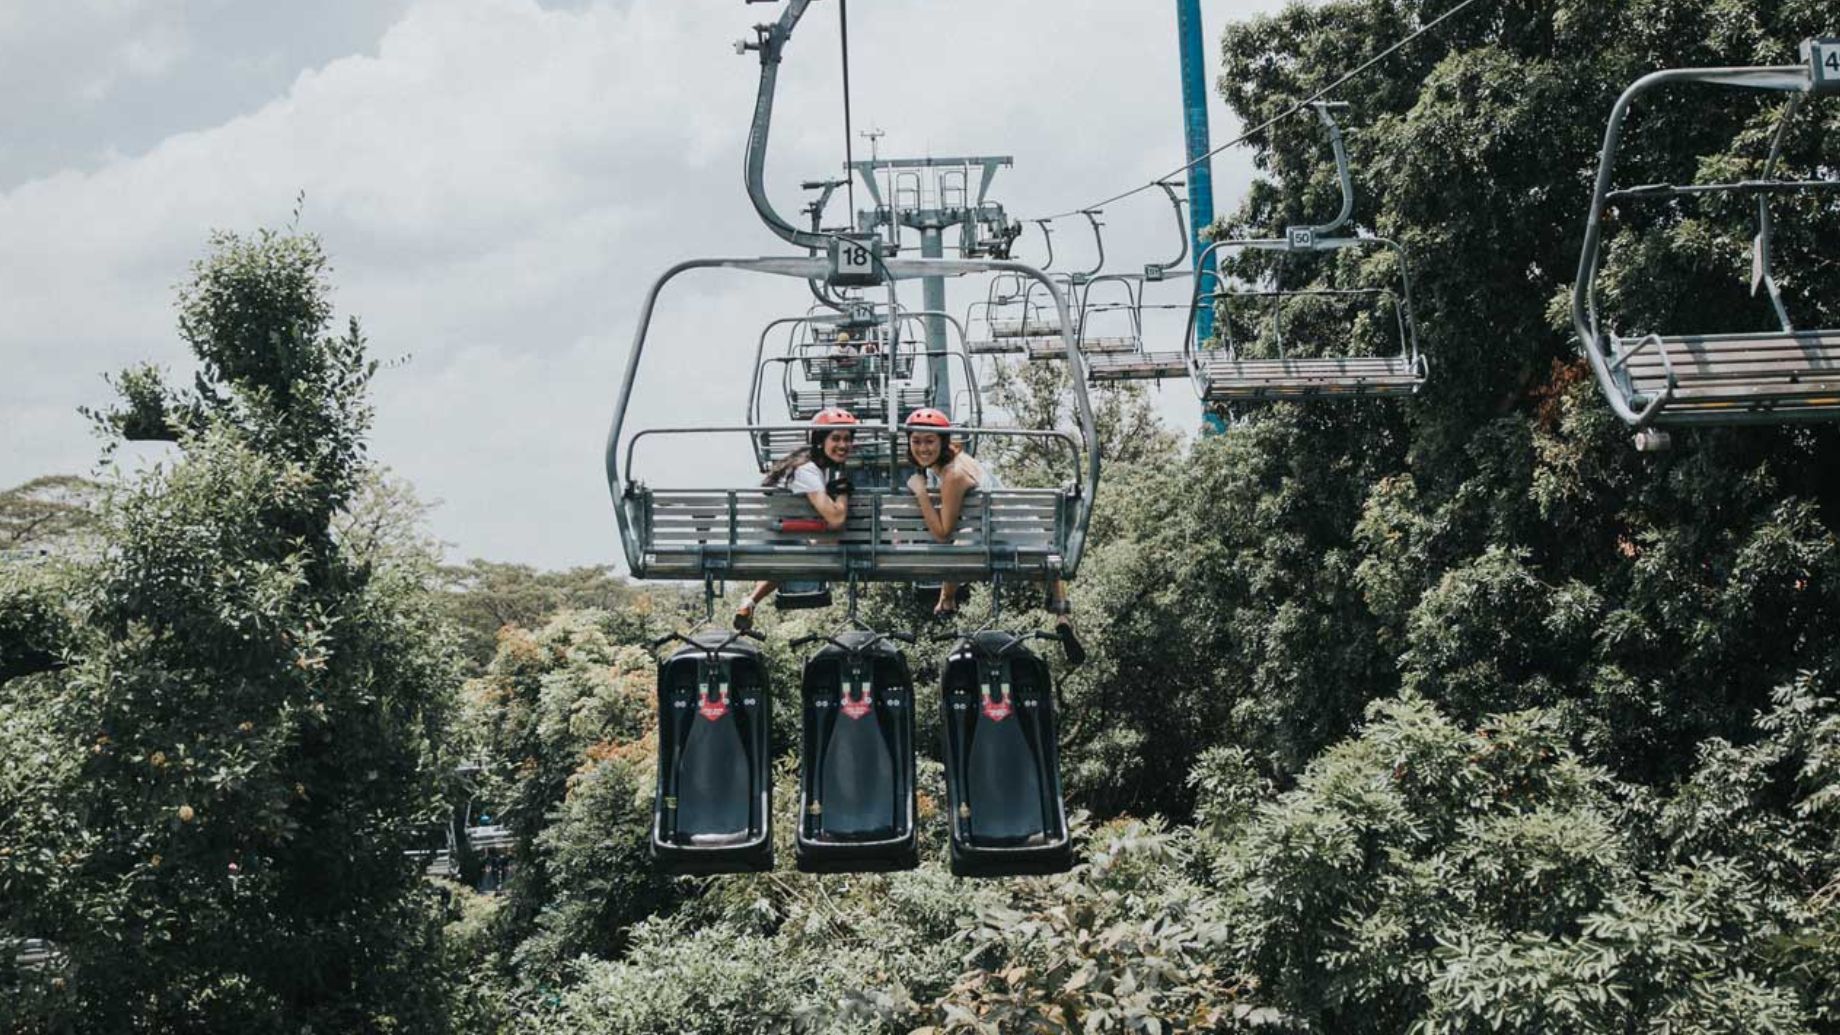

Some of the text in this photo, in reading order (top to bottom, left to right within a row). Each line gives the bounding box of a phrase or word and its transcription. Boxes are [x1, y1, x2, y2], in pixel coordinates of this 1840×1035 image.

[1825, 51, 1840, 71] 4
[1295, 233, 1310, 243] 50
[843, 246, 867, 266] 18
